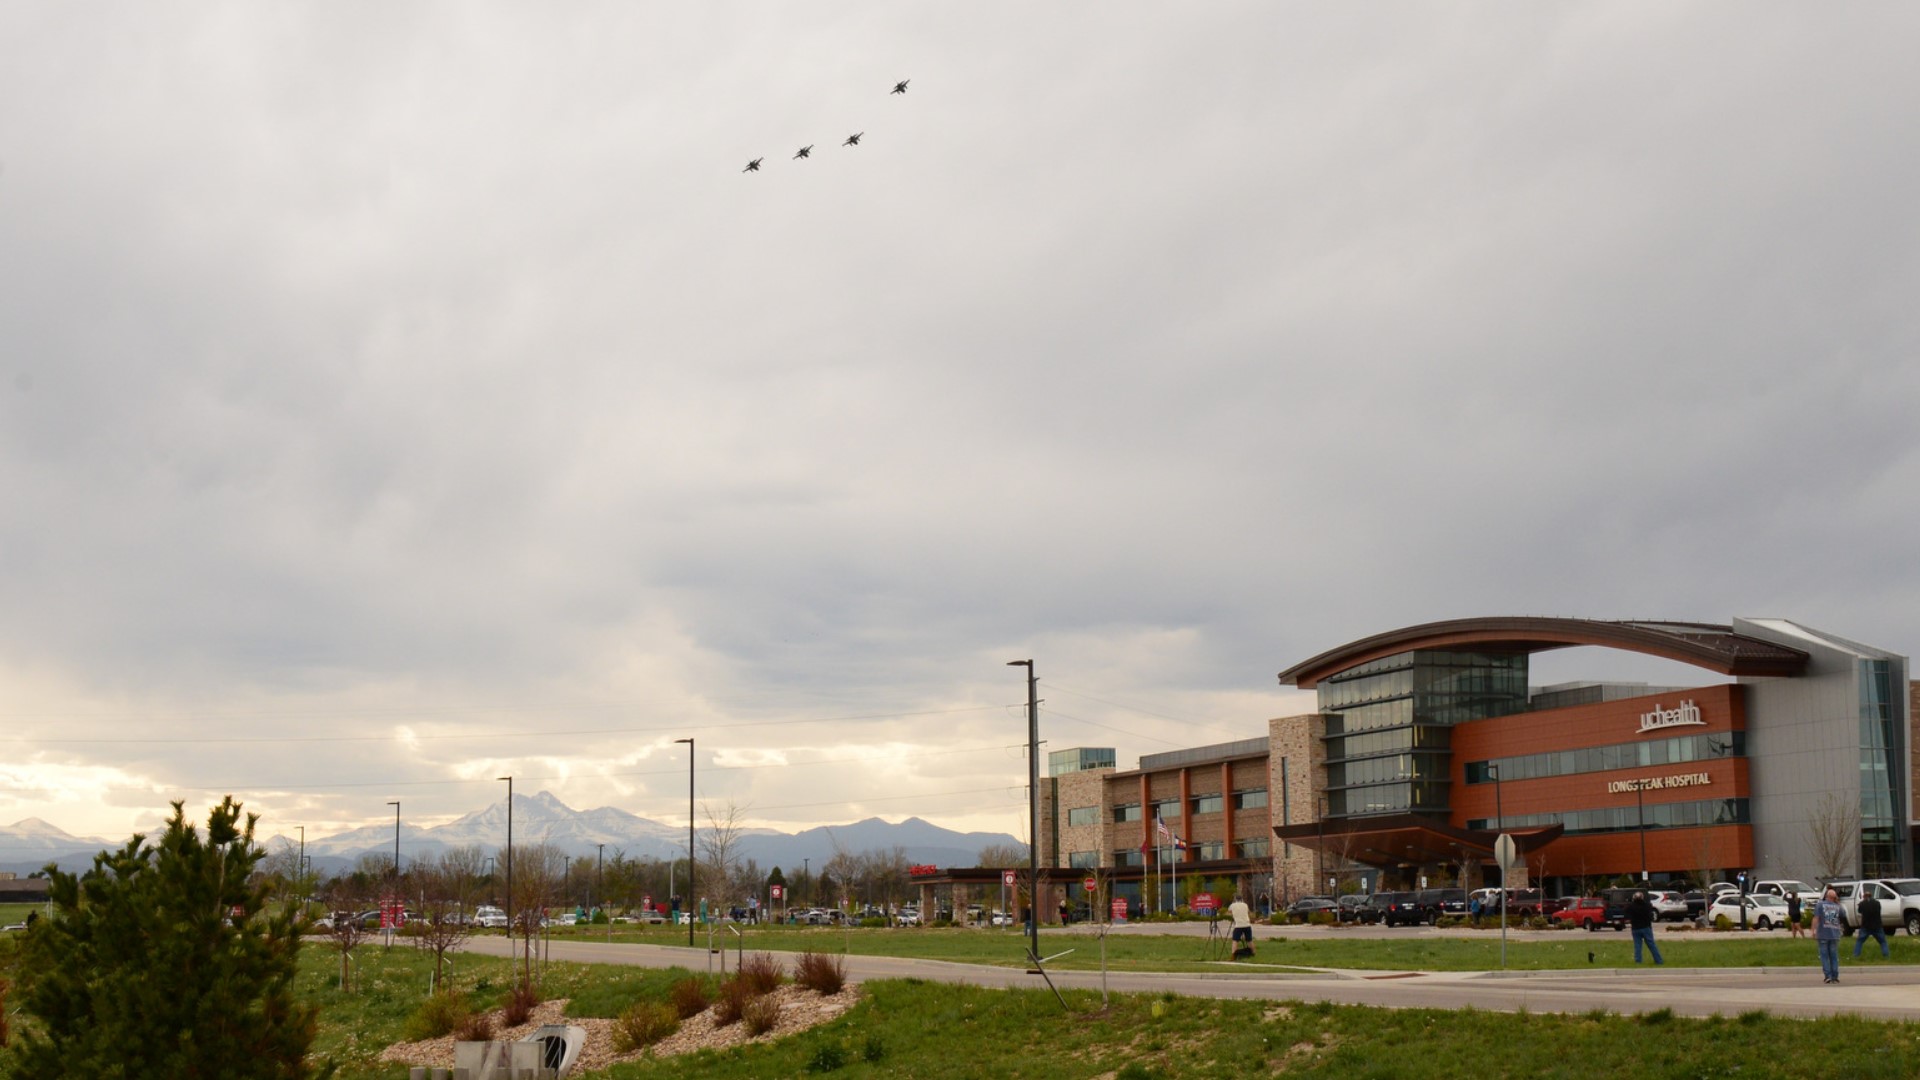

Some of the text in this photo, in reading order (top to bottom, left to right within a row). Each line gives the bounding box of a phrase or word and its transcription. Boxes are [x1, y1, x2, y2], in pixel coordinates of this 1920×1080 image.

[1640, 699, 1701, 729] uchealth
[1608, 780, 1639, 793] LONGS
[1665, 772, 1711, 788] HOSPITAL
